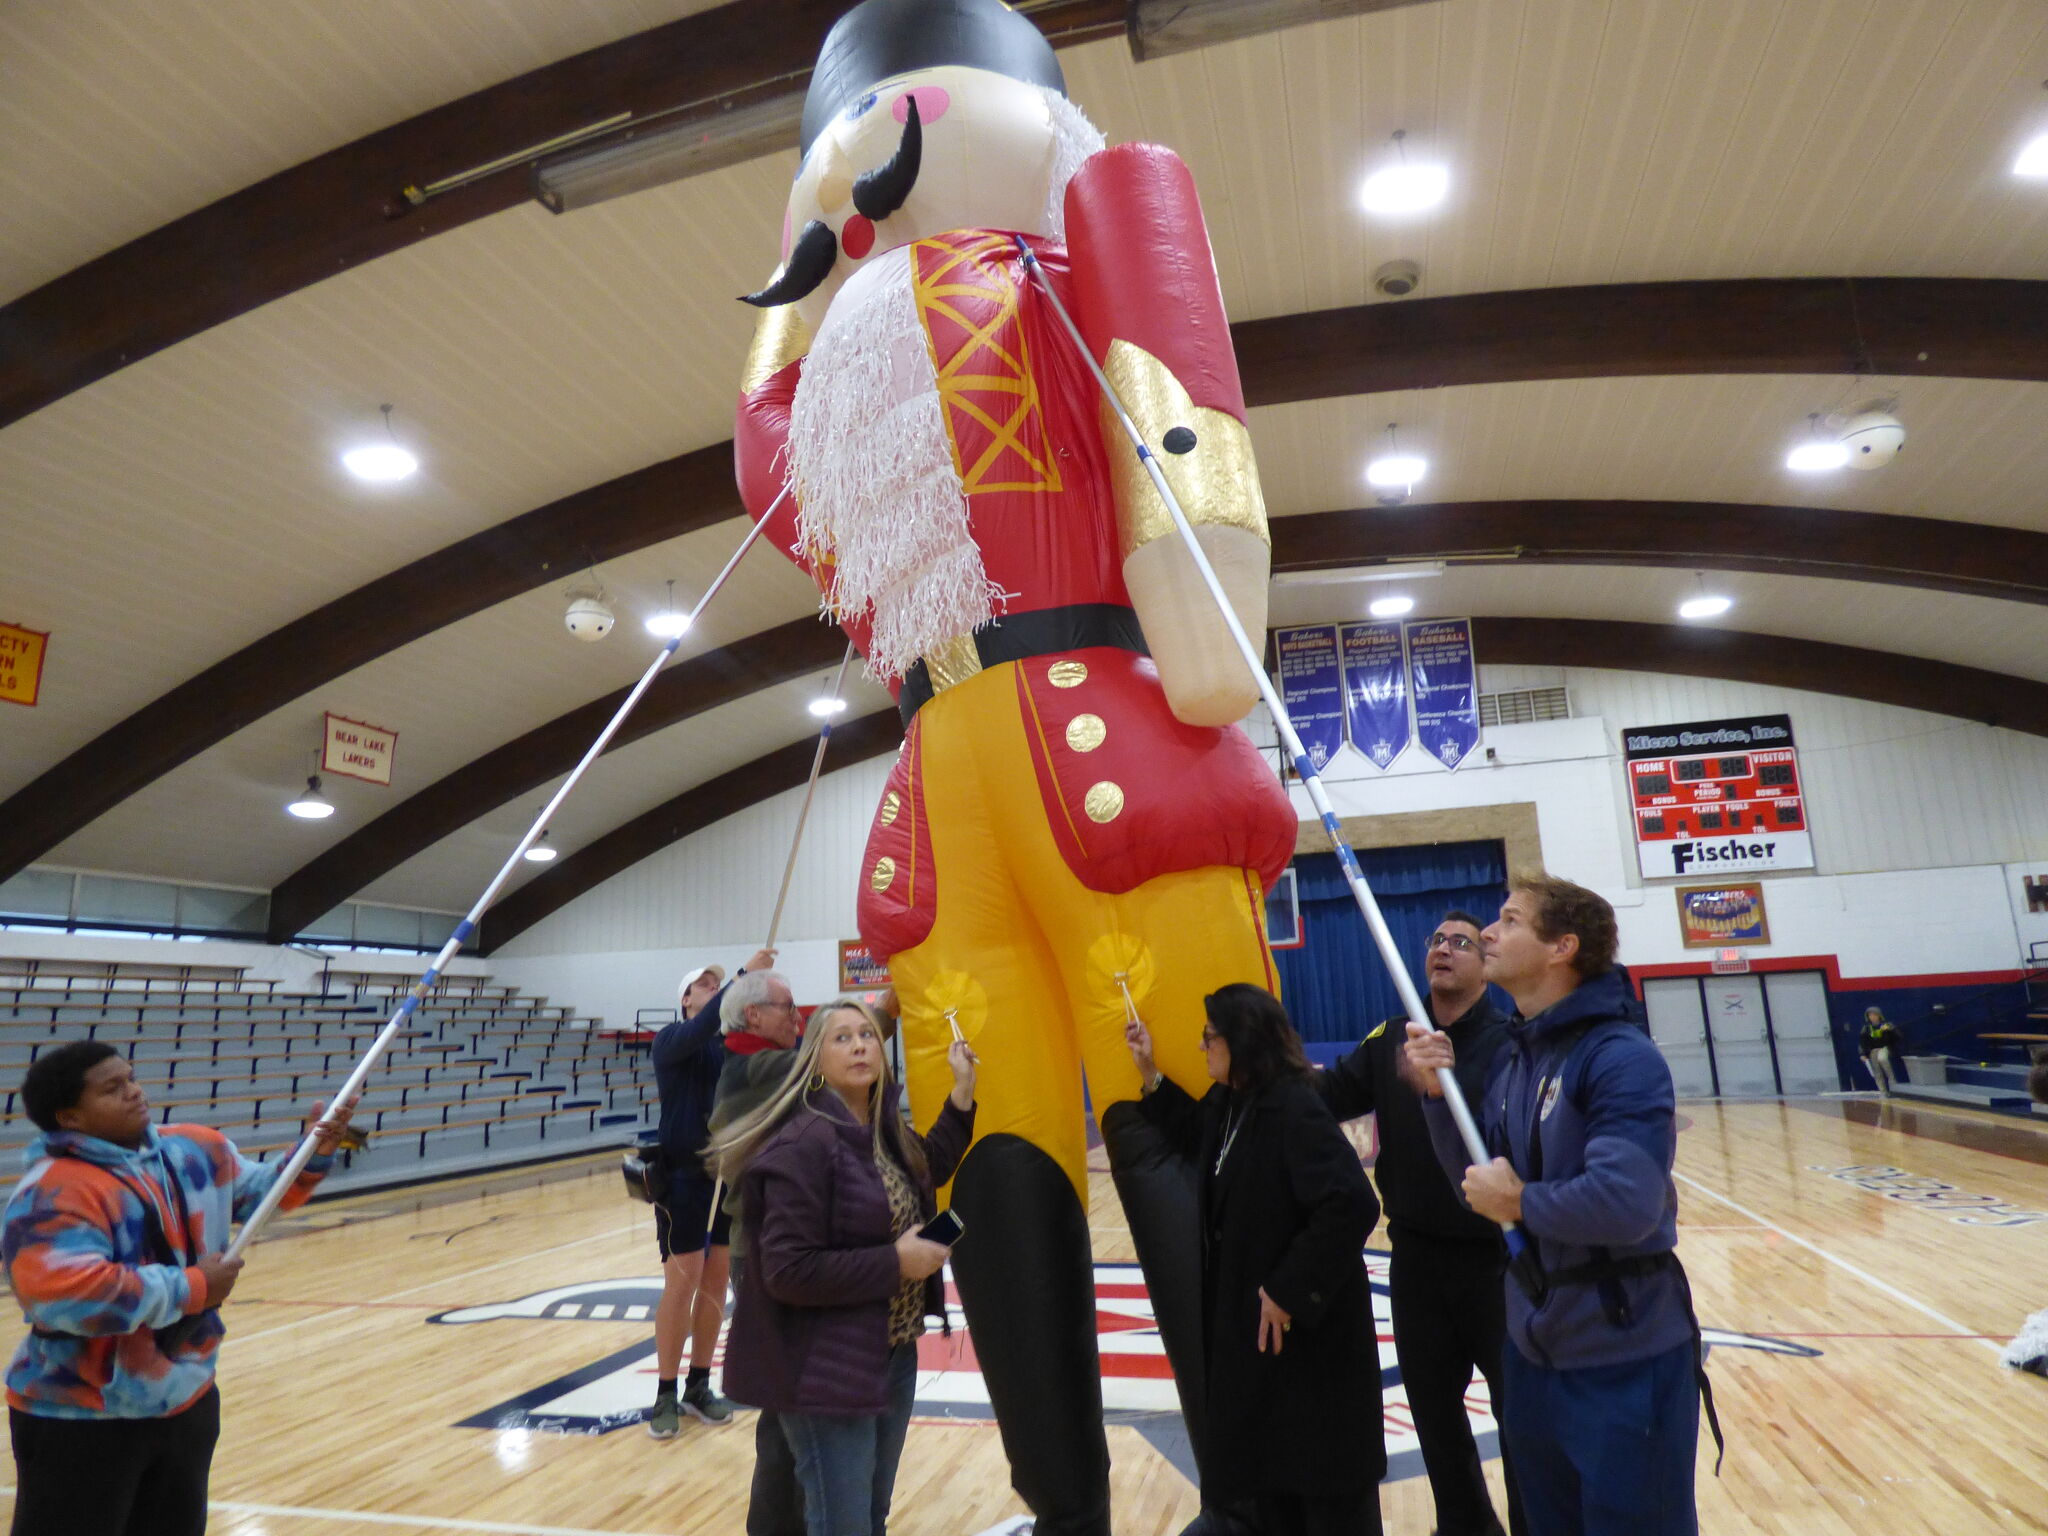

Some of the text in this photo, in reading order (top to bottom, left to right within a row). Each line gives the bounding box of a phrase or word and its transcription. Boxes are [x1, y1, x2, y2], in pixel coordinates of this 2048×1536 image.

[1345, 634, 1399, 648] FOOTBALL
[1412, 632, 1466, 646] BASEBALL
[335, 730, 386, 754] BEAR LAKE
[1628, 725, 1788, 750] Micro Service, Inc.
[342, 751, 376, 769] LAKERS
[1752, 751, 1793, 764] VISITOR
[1635, 761, 1666, 773] HOME
[1694, 787, 1721, 797] PERIOD
[1756, 788, 1781, 797] BONUS
[1652, 796, 1677, 805] BONUS
[1774, 799, 1798, 808] FOULS
[1639, 808, 1663, 818] FOULS
[1693, 802, 1749, 814] PLAYER FOULS
[1671, 839, 1776, 874] Fischer
